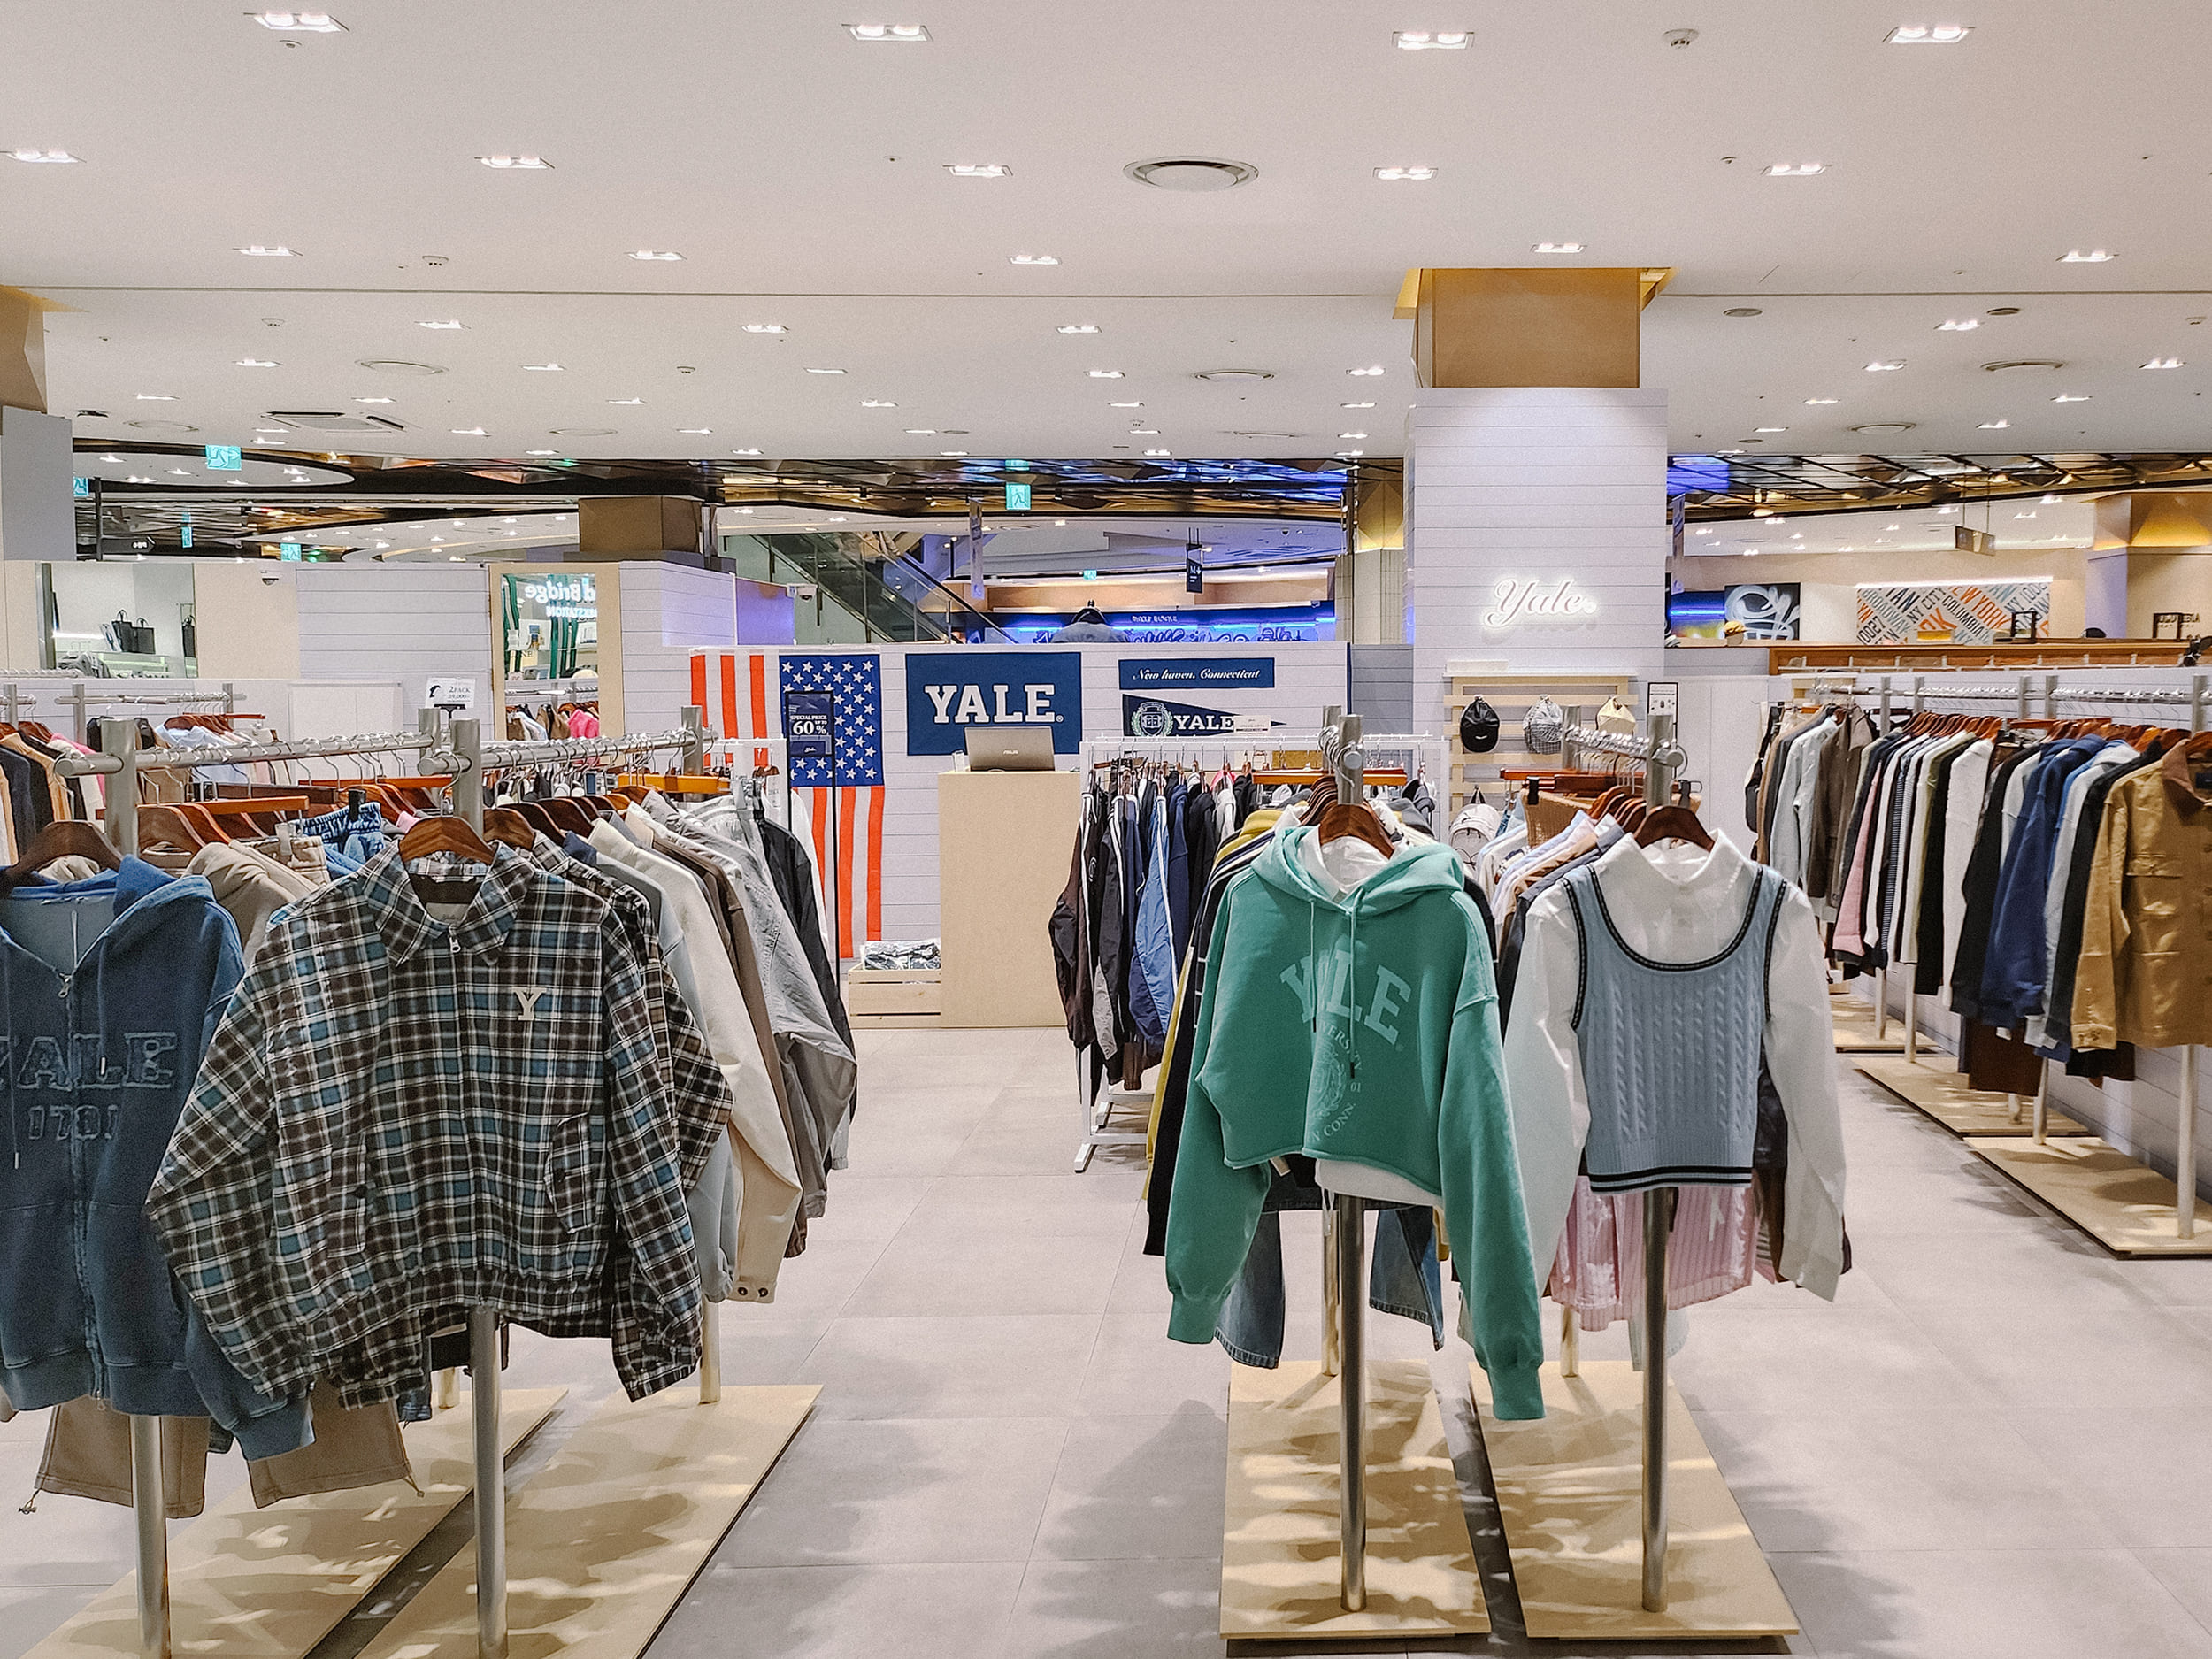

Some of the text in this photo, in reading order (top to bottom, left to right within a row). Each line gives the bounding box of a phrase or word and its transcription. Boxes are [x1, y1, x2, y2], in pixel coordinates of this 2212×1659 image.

[1486, 579, 1581, 627] Yale
[1942, 595, 1985, 638] COLUMBIA
[1133, 668, 1159, 680] New
[1200, 668, 1261, 680] Connecticut
[924, 684, 1056, 724] YALE
[1173, 715, 1233, 731] YALE
[511, 987, 547, 1021] Y
[1324, 1102, 1356, 1137] CONN.
